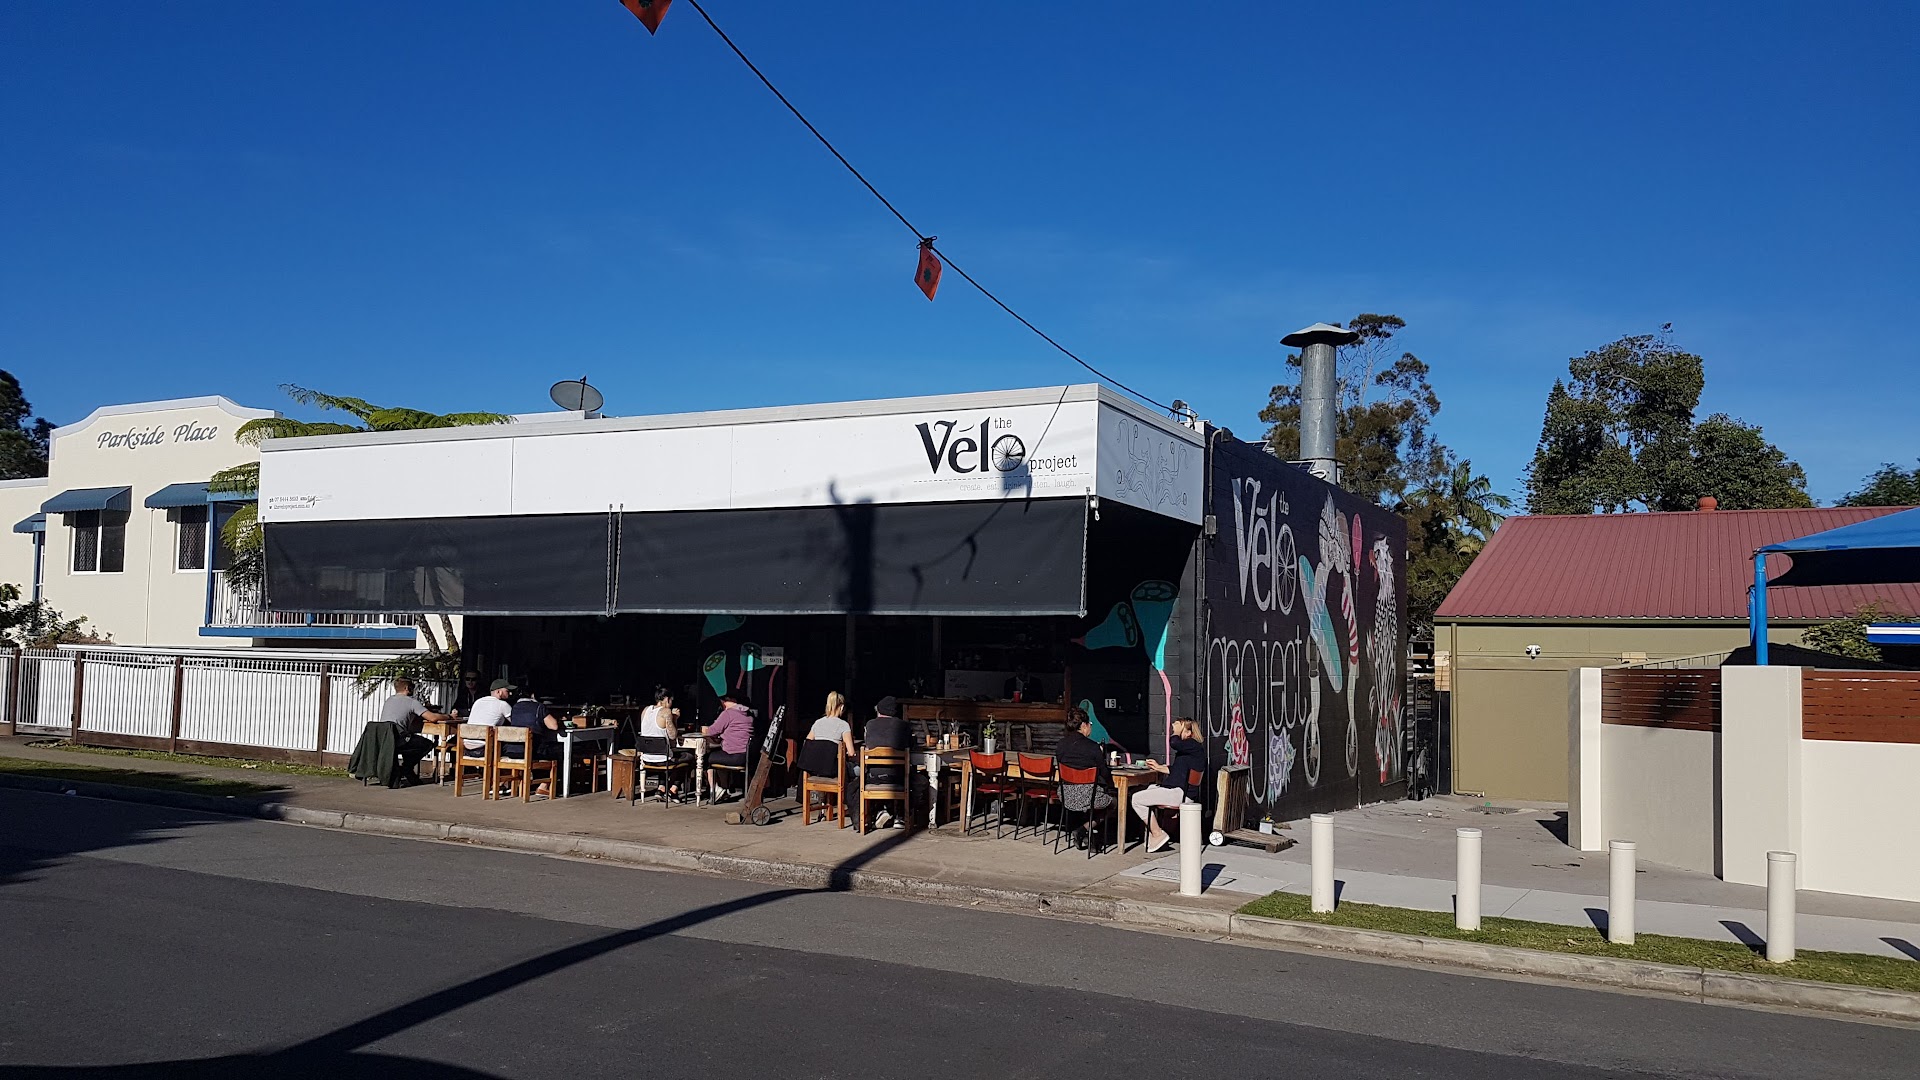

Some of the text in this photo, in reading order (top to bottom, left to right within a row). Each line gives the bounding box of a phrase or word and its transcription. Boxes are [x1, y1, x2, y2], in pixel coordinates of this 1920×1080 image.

[994, 417, 1012, 429] the
[97, 420, 218, 450] Parkside Place
[1029, 454, 1077, 473] project
[1279, 498, 1290, 517] the
[1208, 620, 1307, 804] project
